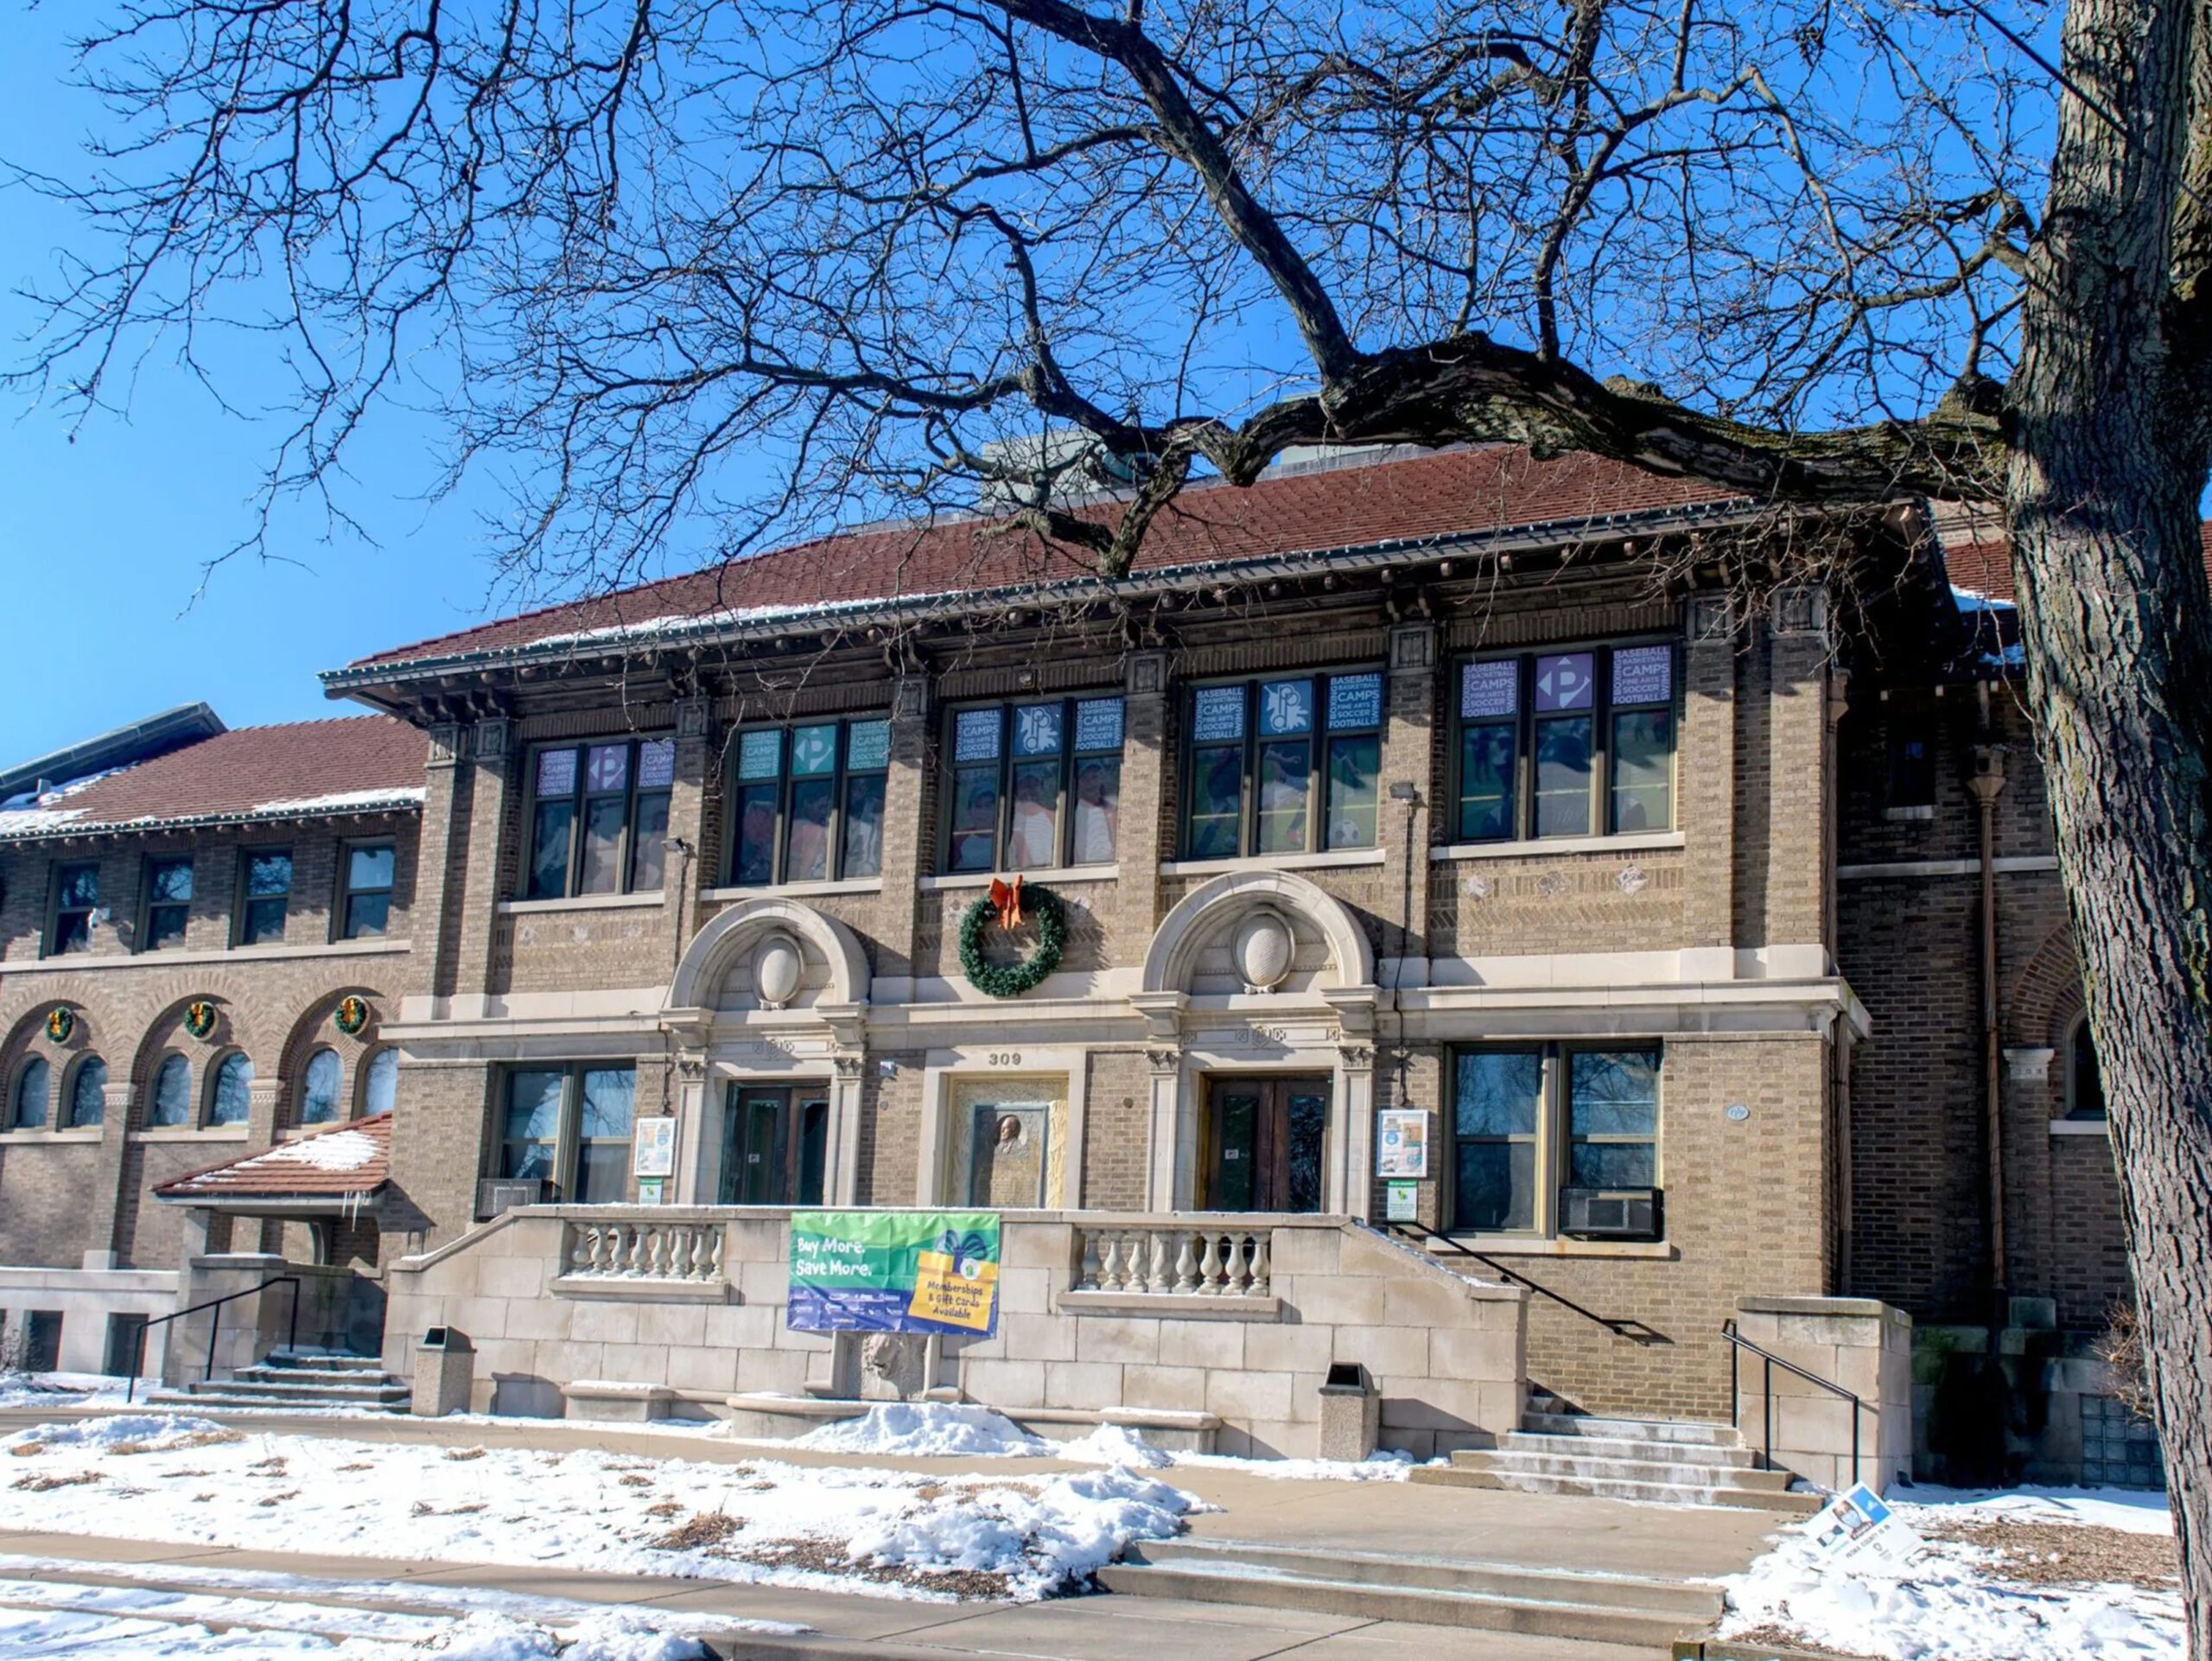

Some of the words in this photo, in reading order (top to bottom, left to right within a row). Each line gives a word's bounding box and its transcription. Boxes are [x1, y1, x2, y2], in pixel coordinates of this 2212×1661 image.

[1614, 646, 1669, 659] BASEBALL
[1463, 662, 1516, 673] BASEBALL
[1623, 664, 1669, 677] CAMPS
[1331, 674, 1380, 685] BASEBALL
[1471, 678, 1515, 691] CAMPS
[1197, 687, 1243, 698] BASEBALL
[1623, 684, 1660, 694] SOCCER
[1338, 690, 1380, 702] CAMPS
[1613, 693, 1660, 705] FOOTBALL
[1470, 698, 1505, 708] SOCCER
[1203, 703, 1243, 716] CAMPS
[1338, 709, 1370, 718] SOCCER
[1462, 707, 1506, 717] FOOTBALL
[1084, 714, 1121, 726] CAMPS
[1329, 717, 1370, 729] FOOTBALL
[963, 725, 999, 736] CAMPS
[1202, 722, 1234, 731] SOCCER
[1083, 732, 1113, 741] SOCCER
[1195, 730, 1234, 741] FOOTBALL
[963, 743, 991, 752] SOCCER
[1075, 740, 1113, 751] FOOTBALL
[747, 746, 779, 757] CAMPS
[956, 751, 991, 761] FOOTBALL
[988, 1052, 1021, 1066] 309
[798, 1237, 819, 1259] Buy
[822, 1237, 866, 1254] More.
[797, 1258, 827, 1276] Save
[830, 1259, 872, 1277] More.
[927, 1281, 982, 1301] Memberships
[928, 1293, 933, 1301] &
[937, 1293, 952, 1306] Gift
[956, 1296, 980, 1308] Cards
[933, 1307, 971, 1319] Available
